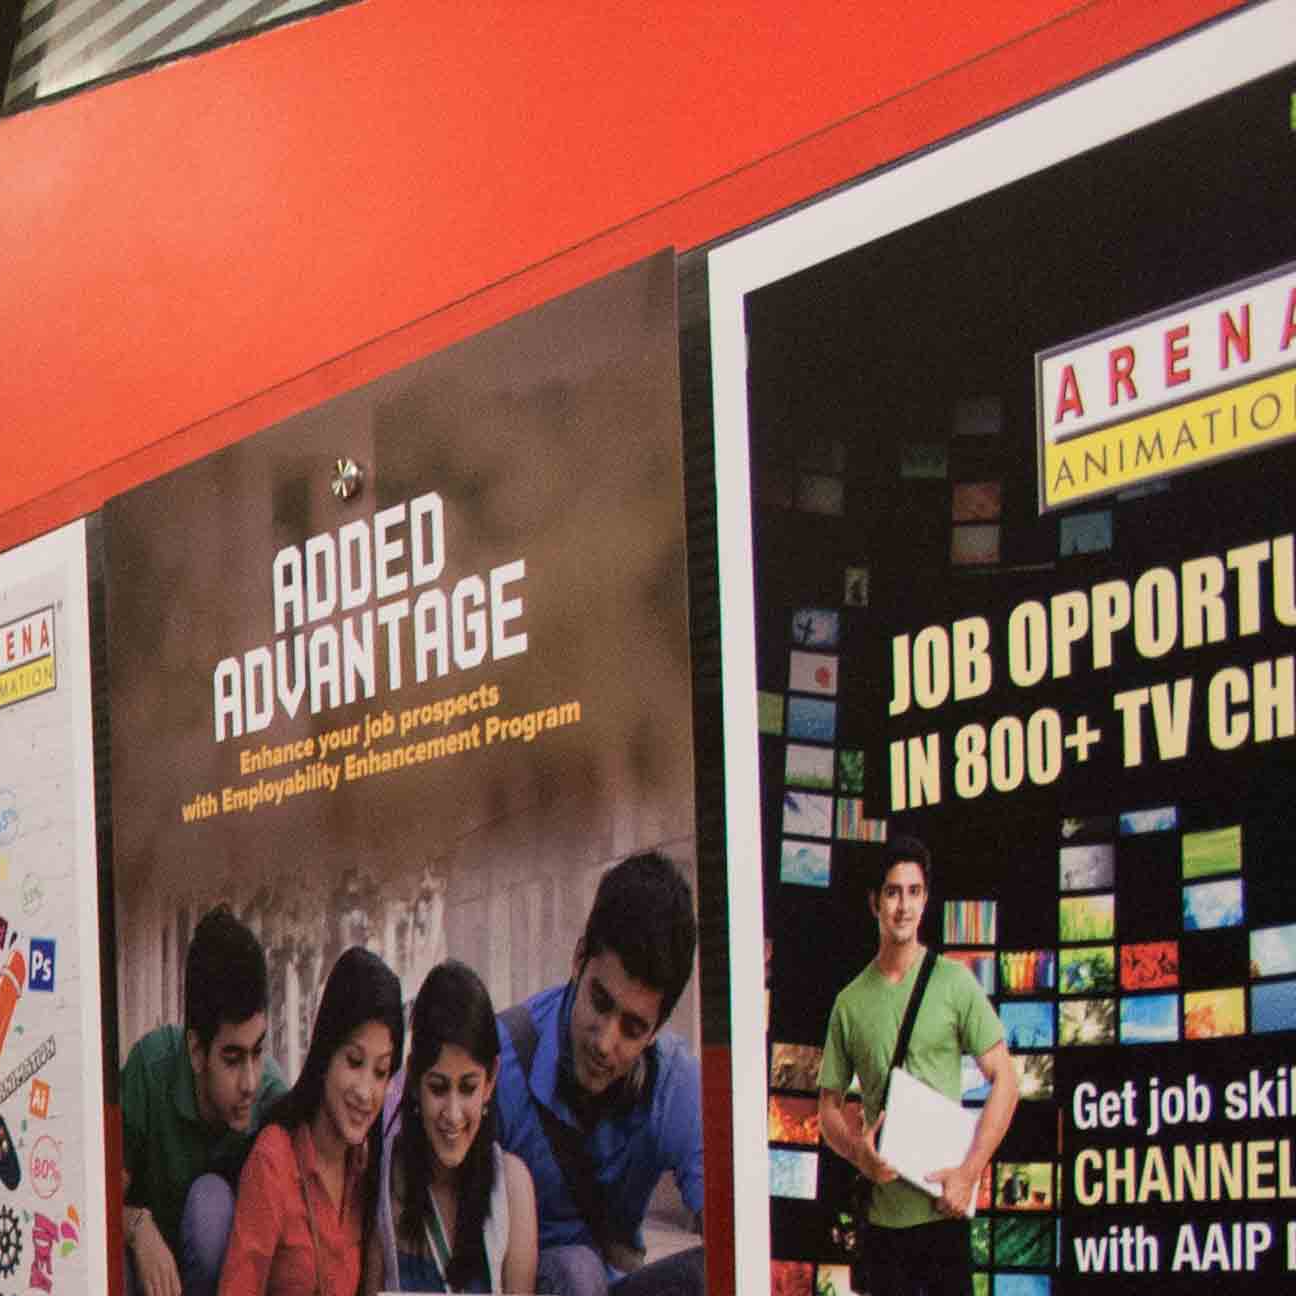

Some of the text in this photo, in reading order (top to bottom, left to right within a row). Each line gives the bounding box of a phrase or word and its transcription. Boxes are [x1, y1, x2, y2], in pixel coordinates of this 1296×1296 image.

[1052, 384, 1296, 492] ANIMATIO
[272, 491, 446, 633] ADDED
[213, 560, 528, 742] ADVANTAGE
[889, 616, 992, 716] JOB
[181, 700, 581, 822] with Employability Enhancement Program
[240, 682, 501, 776] Enhance your job prospects
[889, 733, 942, 812] IN
[954, 707, 1102, 800] 800+
[1114, 678, 1193, 768] TV
[32, 950, 53, 982] Ps
[1073, 1081, 1139, 1130] Get
[1147, 1073, 1212, 1136] job
[1074, 1138, 1296, 1206] CHANNEL
[1073, 1223, 1158, 1273] with
[1171, 1221, 1272, 1272] AAIP
